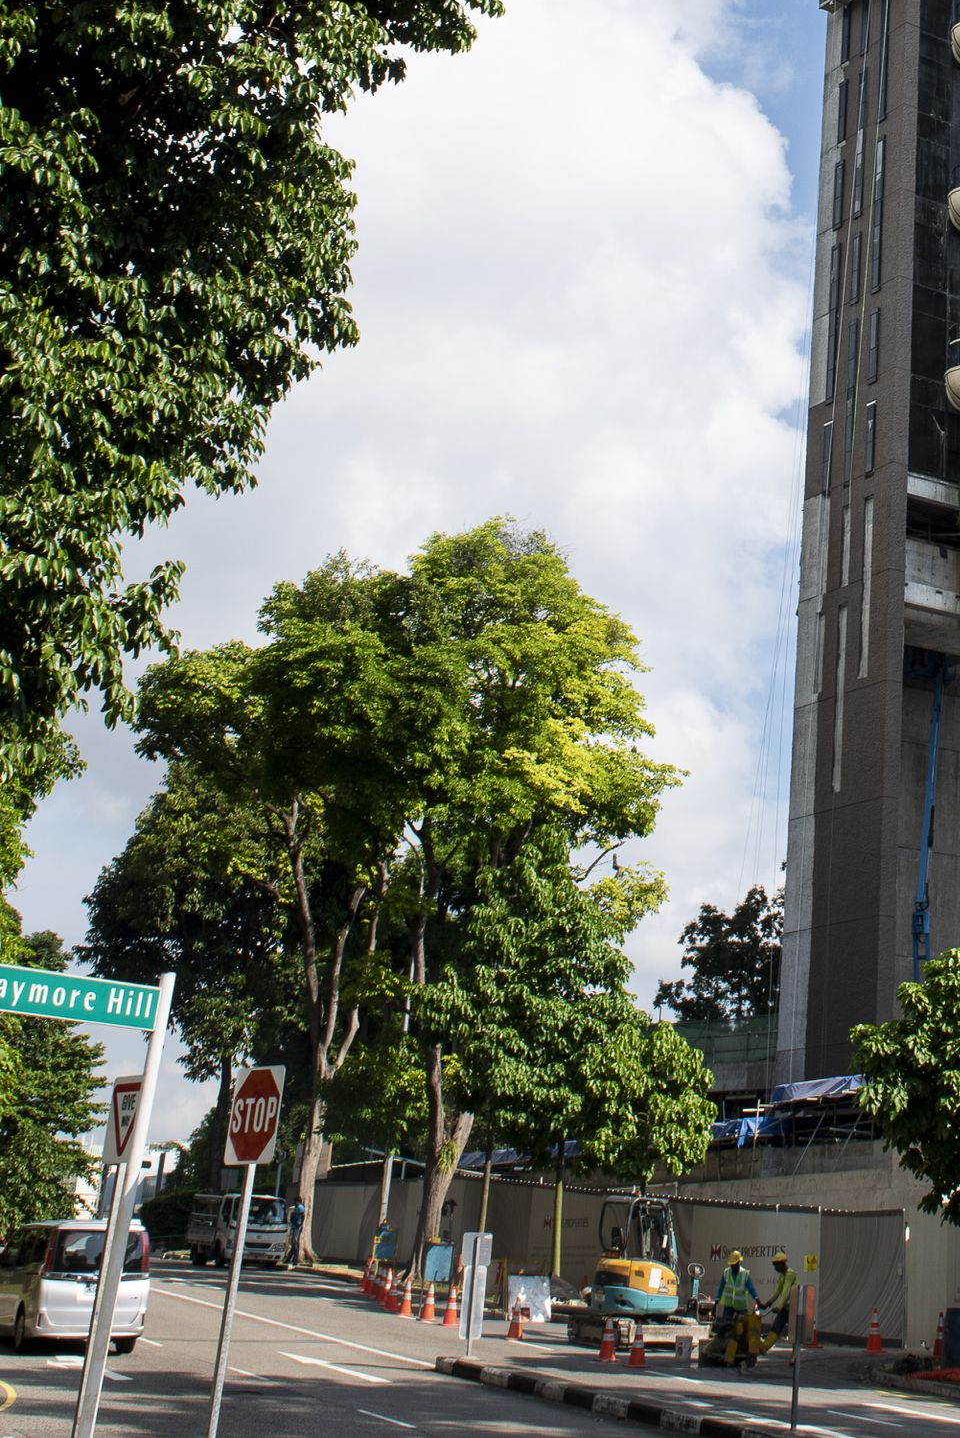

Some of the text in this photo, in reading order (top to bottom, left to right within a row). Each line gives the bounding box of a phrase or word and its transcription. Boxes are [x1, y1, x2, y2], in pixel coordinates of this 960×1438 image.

[107, 987, 153, 1019] Hill
[121, 1093, 137, 1111] GIVE
[232, 1096, 278, 1134] STOP
